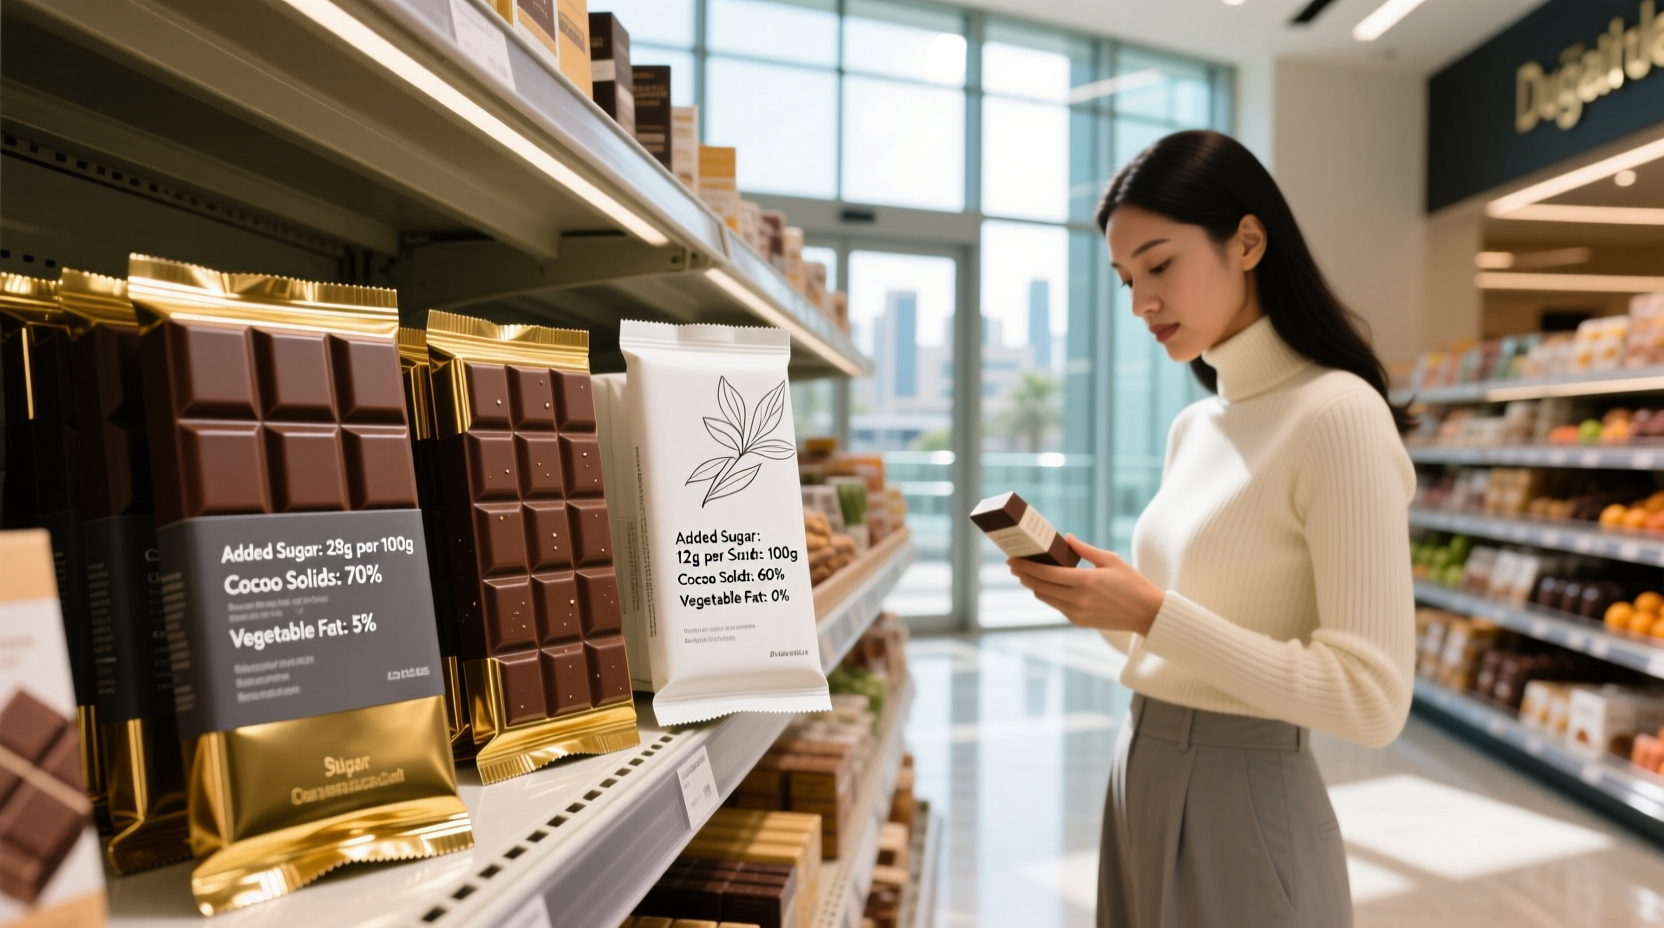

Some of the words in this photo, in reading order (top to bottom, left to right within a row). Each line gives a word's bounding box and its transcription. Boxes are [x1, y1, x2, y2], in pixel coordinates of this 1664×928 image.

[675, 529, 718, 545] Added
[720, 530, 761, 546] Sugar:
[221, 542, 273, 564] Added
[276, 541, 323, 562] Sugar:
[326, 538, 353, 559] 28g
[381, 536, 414, 554] 100g
[676, 549, 700, 567] 12g
[704, 551, 724, 566] per
[768, 546, 798, 562] 100g
[285, 567, 342, 590] Solids:
[344, 564, 383, 585] 70%
[757, 567, 785, 581] 60%
[679, 590, 742, 610] Vegetable
[744, 590, 768, 604] Fat:
[771, 589, 790, 602] 0%
[229, 620, 315, 651] Vegetable
[318, 618, 349, 638] Fat:
[352, 612, 377, 634] 5%
